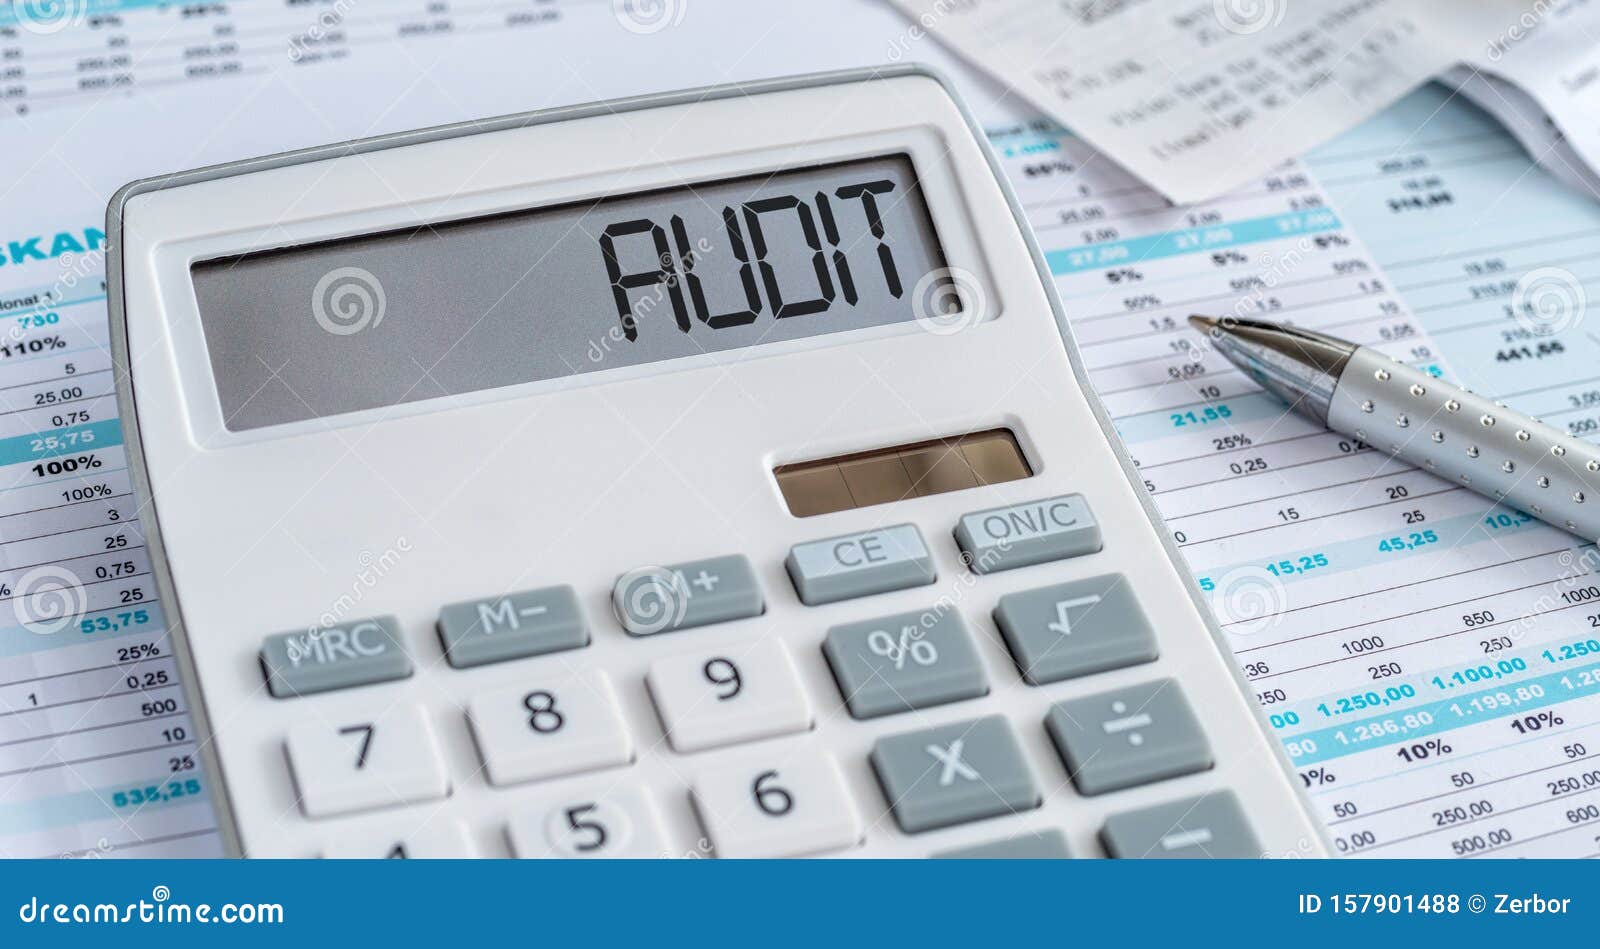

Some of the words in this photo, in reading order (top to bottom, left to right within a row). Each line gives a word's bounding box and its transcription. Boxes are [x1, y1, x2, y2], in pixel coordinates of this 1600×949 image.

[599, 179, 903, 342] AUDIT
[65, 363, 76, 375] 5
[34, 386, 83, 406] 25,00
[52, 410, 90, 428] 0,75
[1170, 405, 1233, 428] 21,55
[30, 429, 96, 453] 25,75
[1212, 433, 1253, 452] 25%
[32, 454, 102, 478] 100%
[1229, 456, 1268, 476] 0,25
[62, 483, 112, 502] 100%
[1278, 507, 1300, 523] 15
[1385, 485, 1409, 500] 20
[108, 508, 120, 521] 3
[984, 503, 1078, 541] ON/C
[1402, 509, 1426, 524] 25
[104, 534, 128, 550] 25
[833, 537, 889, 567] CE
[1266, 552, 1329, 578] 15,25
[1377, 529, 1438, 554] 45,25
[95, 560, 136, 580] 0,75
[119, 587, 145, 603] 25
[80, 609, 149, 635] 53,75
[1341, 635, 1385, 656] 1000
[1462, 610, 1495, 628] 850
[1561, 586, 1600, 604] 1000
[117, 642, 160, 662] 25%
[287, 622, 386, 669] MRC
[1367, 660, 1403, 681] 250
[1479, 636, 1513, 654] 250
[127, 670, 169, 690] 0,25
[704, 657, 743, 700] 9
[1316, 682, 1417, 718] 1.250,00
[1431, 656, 1527, 690] 1.100,00
[141, 698, 177, 718] 500
[522, 690, 565, 734] 8
[1334, 709, 1434, 746] 1.286,80
[1449, 683, 1546, 718] 1.199,80
[163, 726, 186, 743] 10
[338, 723, 376, 769] 7
[1397, 738, 1452, 764] 10%
[1511, 710, 1564, 735] 10%
[169, 755, 195, 773] 25
[112, 778, 201, 808] 535,25
[752, 769, 795, 817] 6
[1333, 801, 1358, 818] 50
[1450, 771, 1475, 788] 50
[1563, 742, 1587, 759] 50
[1432, 799, 1494, 827] 250,00
[566, 803, 608, 852] 5
[1451, 828, 1513, 856] 500,00
